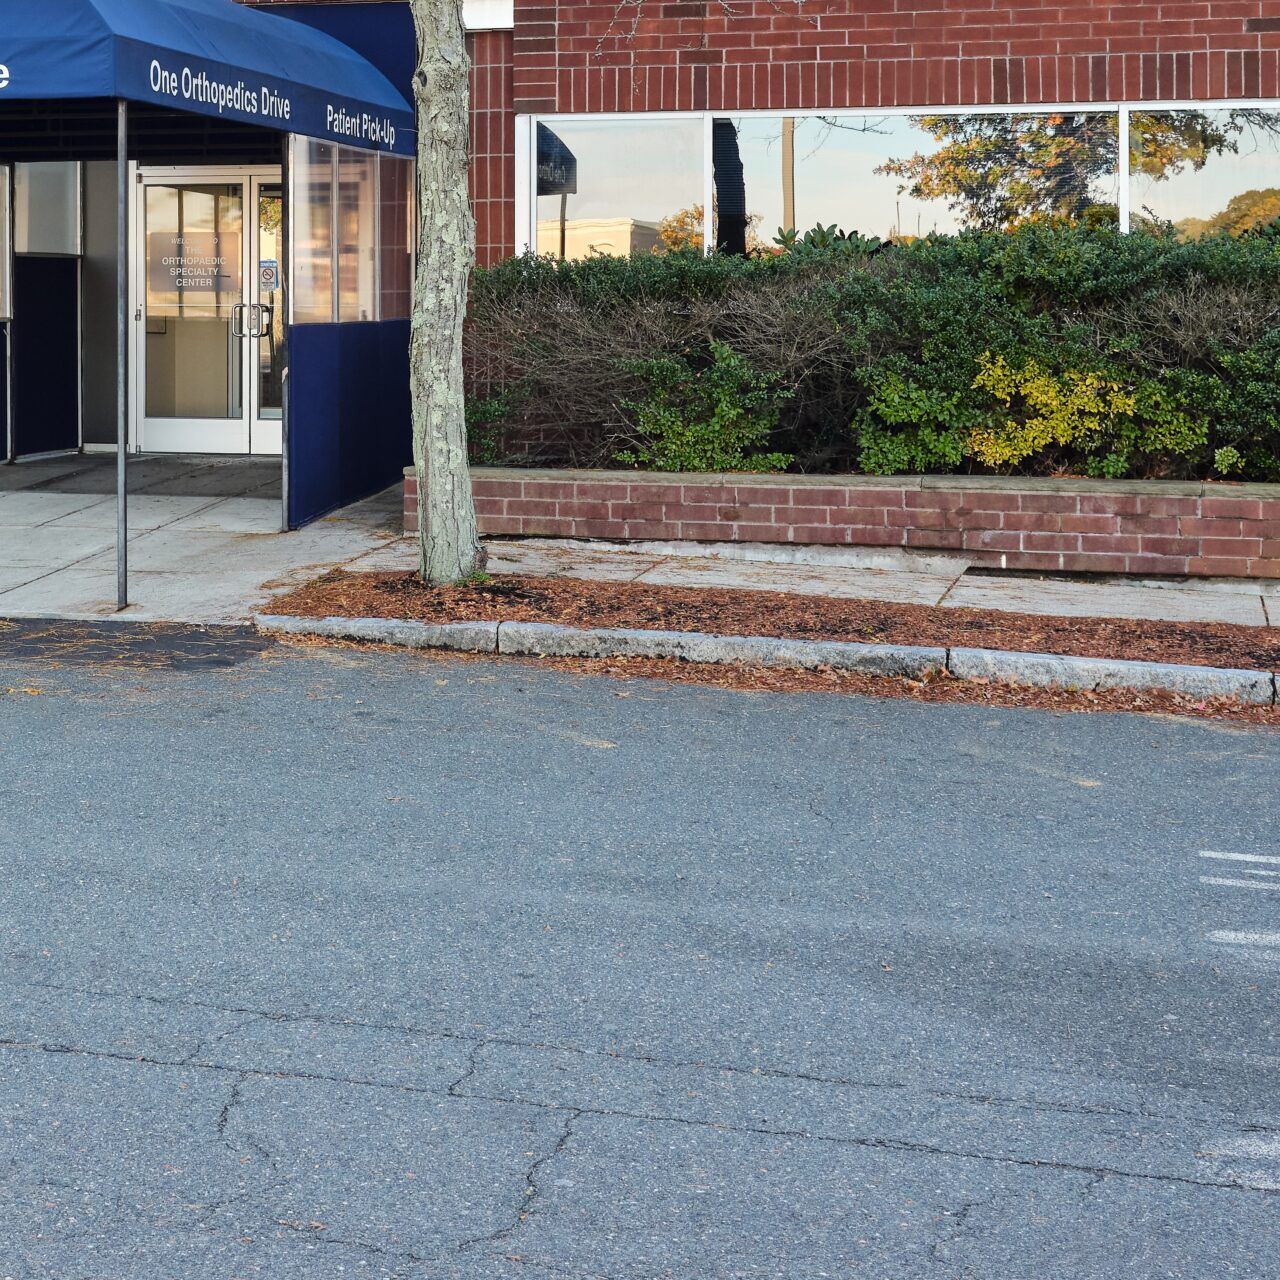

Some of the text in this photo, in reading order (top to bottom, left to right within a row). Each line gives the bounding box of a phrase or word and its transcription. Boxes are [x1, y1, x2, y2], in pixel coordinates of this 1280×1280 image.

[149, 59, 291, 120] One Orthopedics Drive
[327, 104, 395, 150] Patient Pick-Up
[161, 257, 227, 265] ORTHOPAEDIC
[169, 267, 219, 276] SPECIALTY
[175, 278, 213, 287] CENTER
